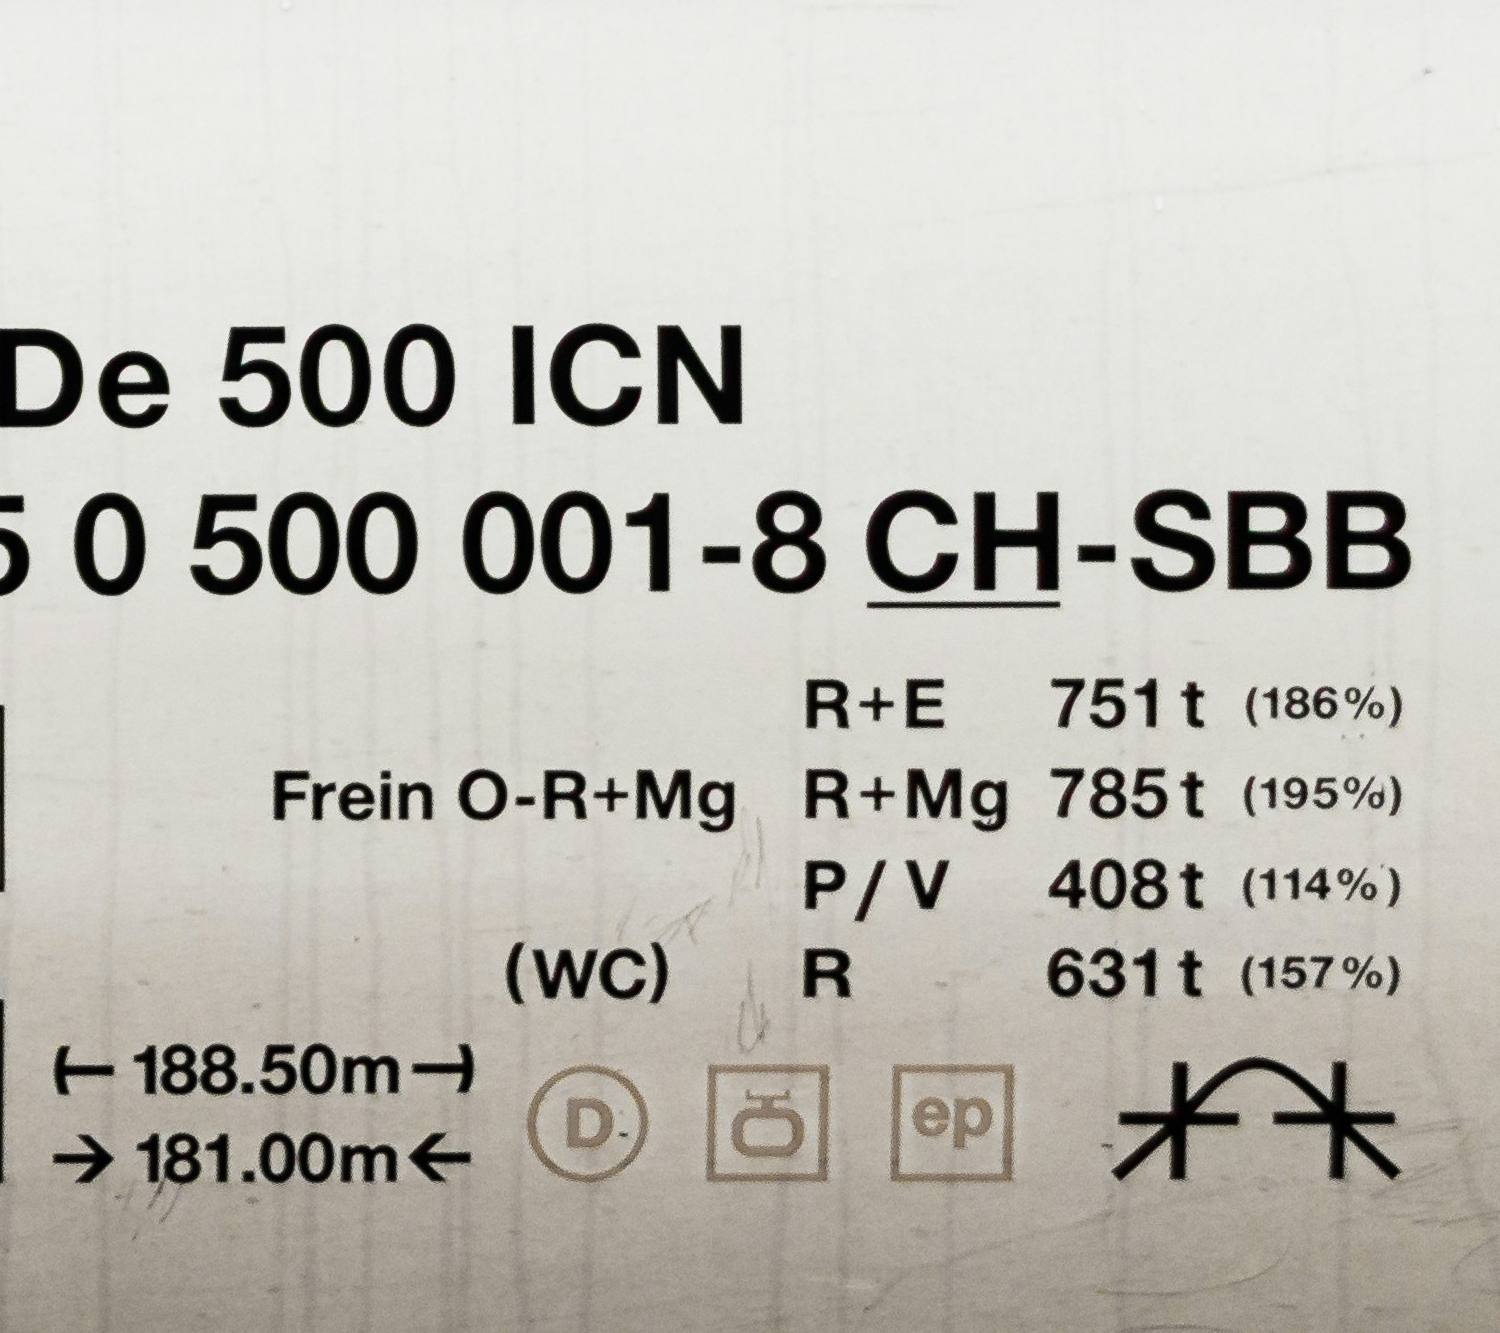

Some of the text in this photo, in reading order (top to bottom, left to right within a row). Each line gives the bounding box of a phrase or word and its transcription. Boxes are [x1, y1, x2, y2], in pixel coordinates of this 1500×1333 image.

[220, 324, 455, 427] 500
[513, 323, 742, 427] ICN
[74, 493, 145, 596] 0
[191, 492, 418, 595] 500
[463, 491, 826, 594] 001-8
[866, 489, 1411, 595] CH-SBB
[274, 771, 433, 821] Frein
[506, 942, 668, 1004] (WC)
[804, 948, 850, 998] R
[134, 1043, 399, 1096] 188.50m
[566, 1098, 614, 1152] D
[912, 1097, 993, 1150] ep
[137, 1132, 397, 1185] 181.00m
